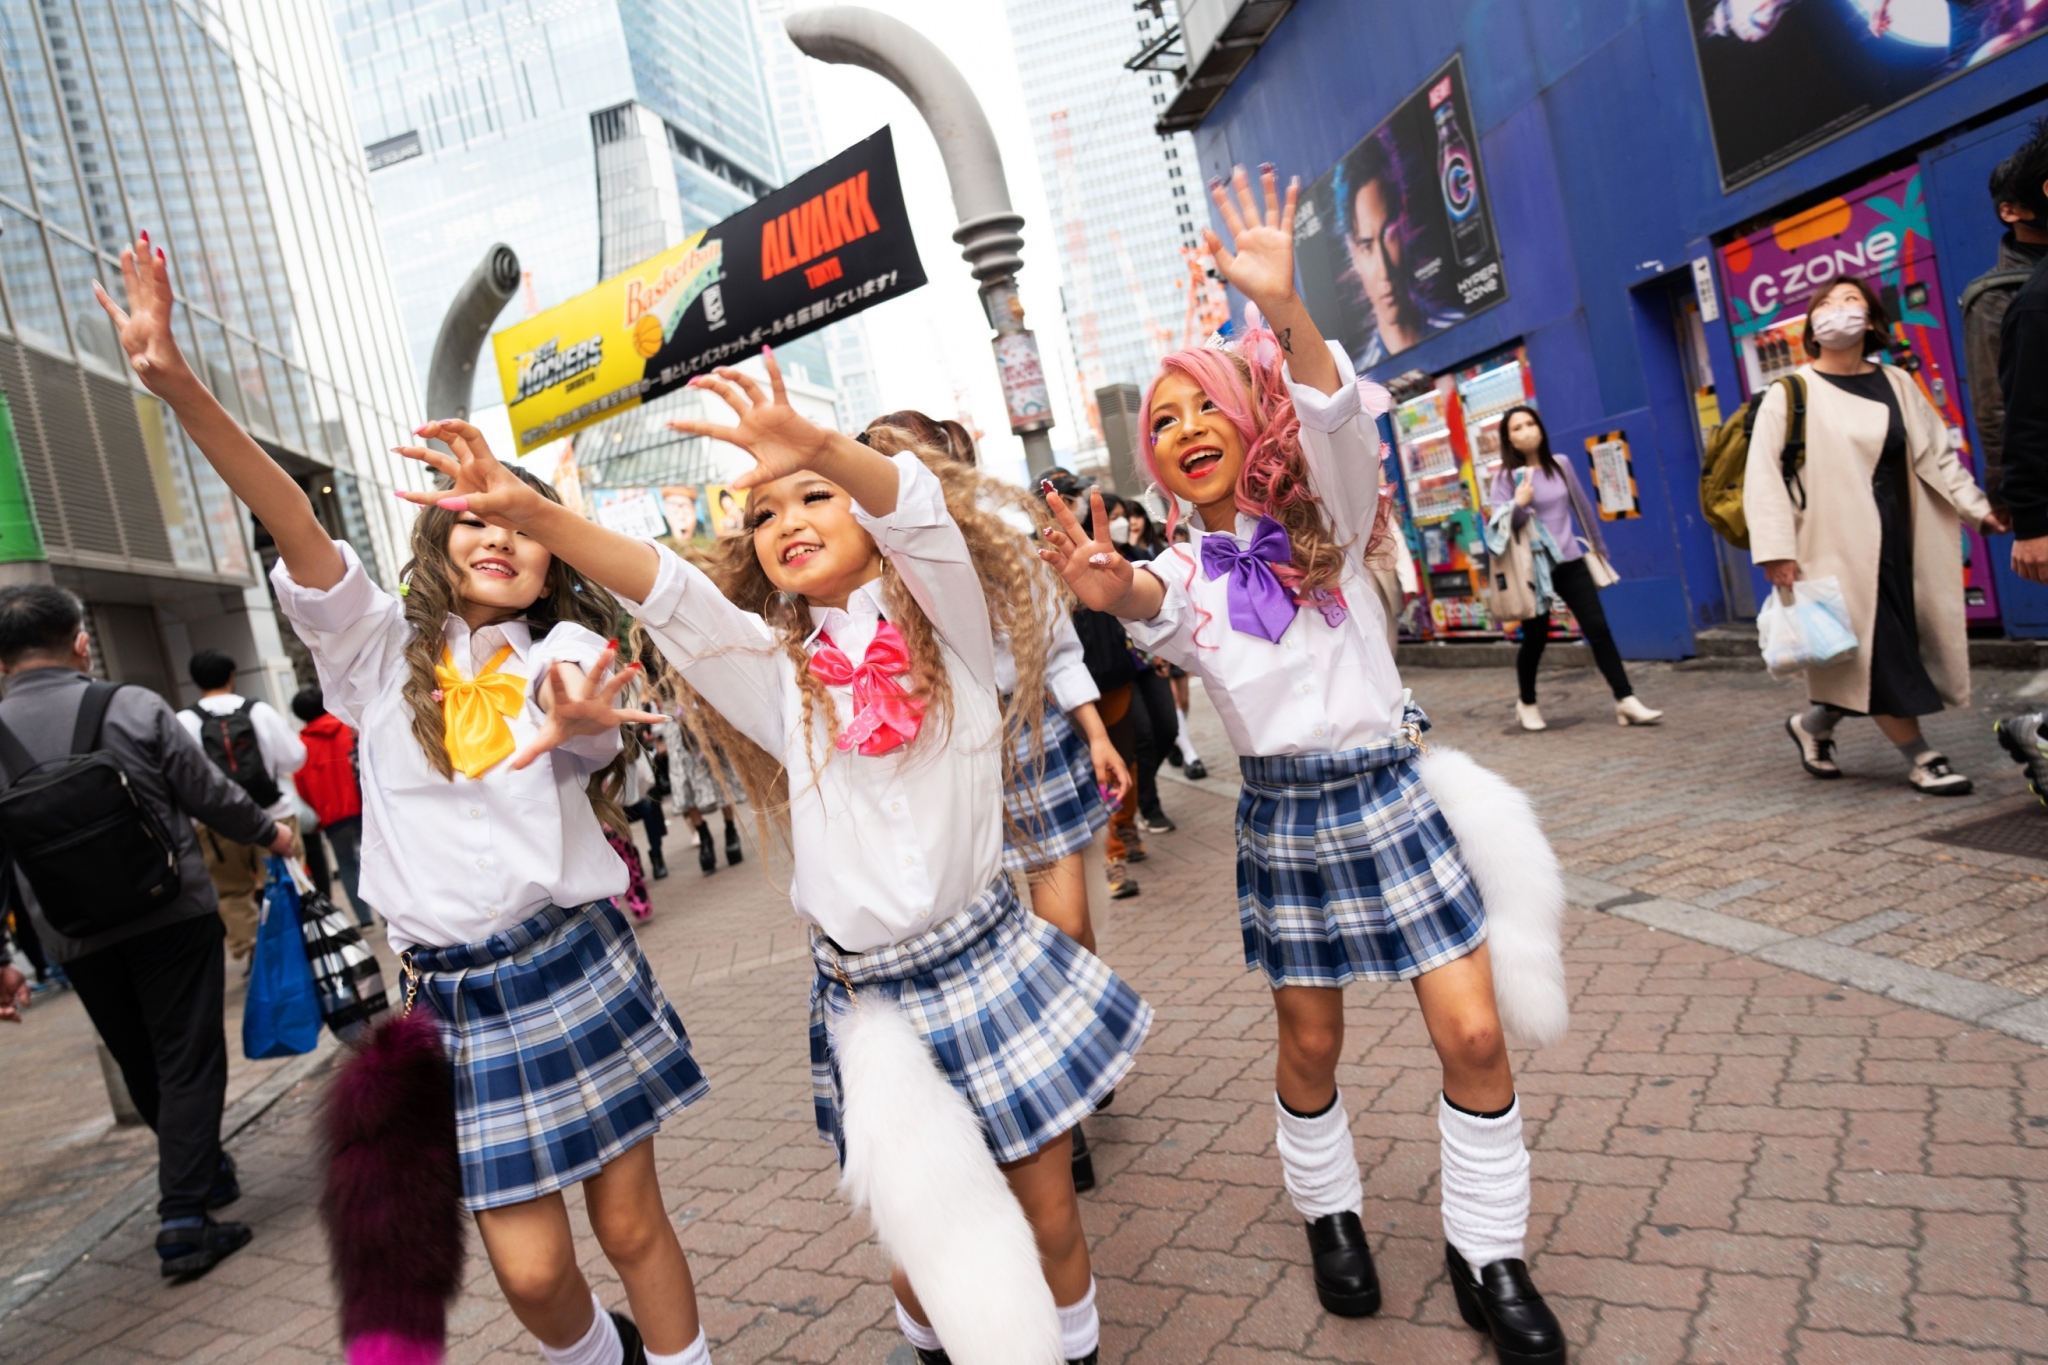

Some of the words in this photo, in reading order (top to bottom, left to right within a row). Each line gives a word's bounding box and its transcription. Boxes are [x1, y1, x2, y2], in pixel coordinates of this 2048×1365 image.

[761, 169, 881, 281] ALVARK
[624, 240, 721, 328] Basketball
[1457, 262, 1499, 294] HYPER
[510, 334, 604, 407] ROCKERS
